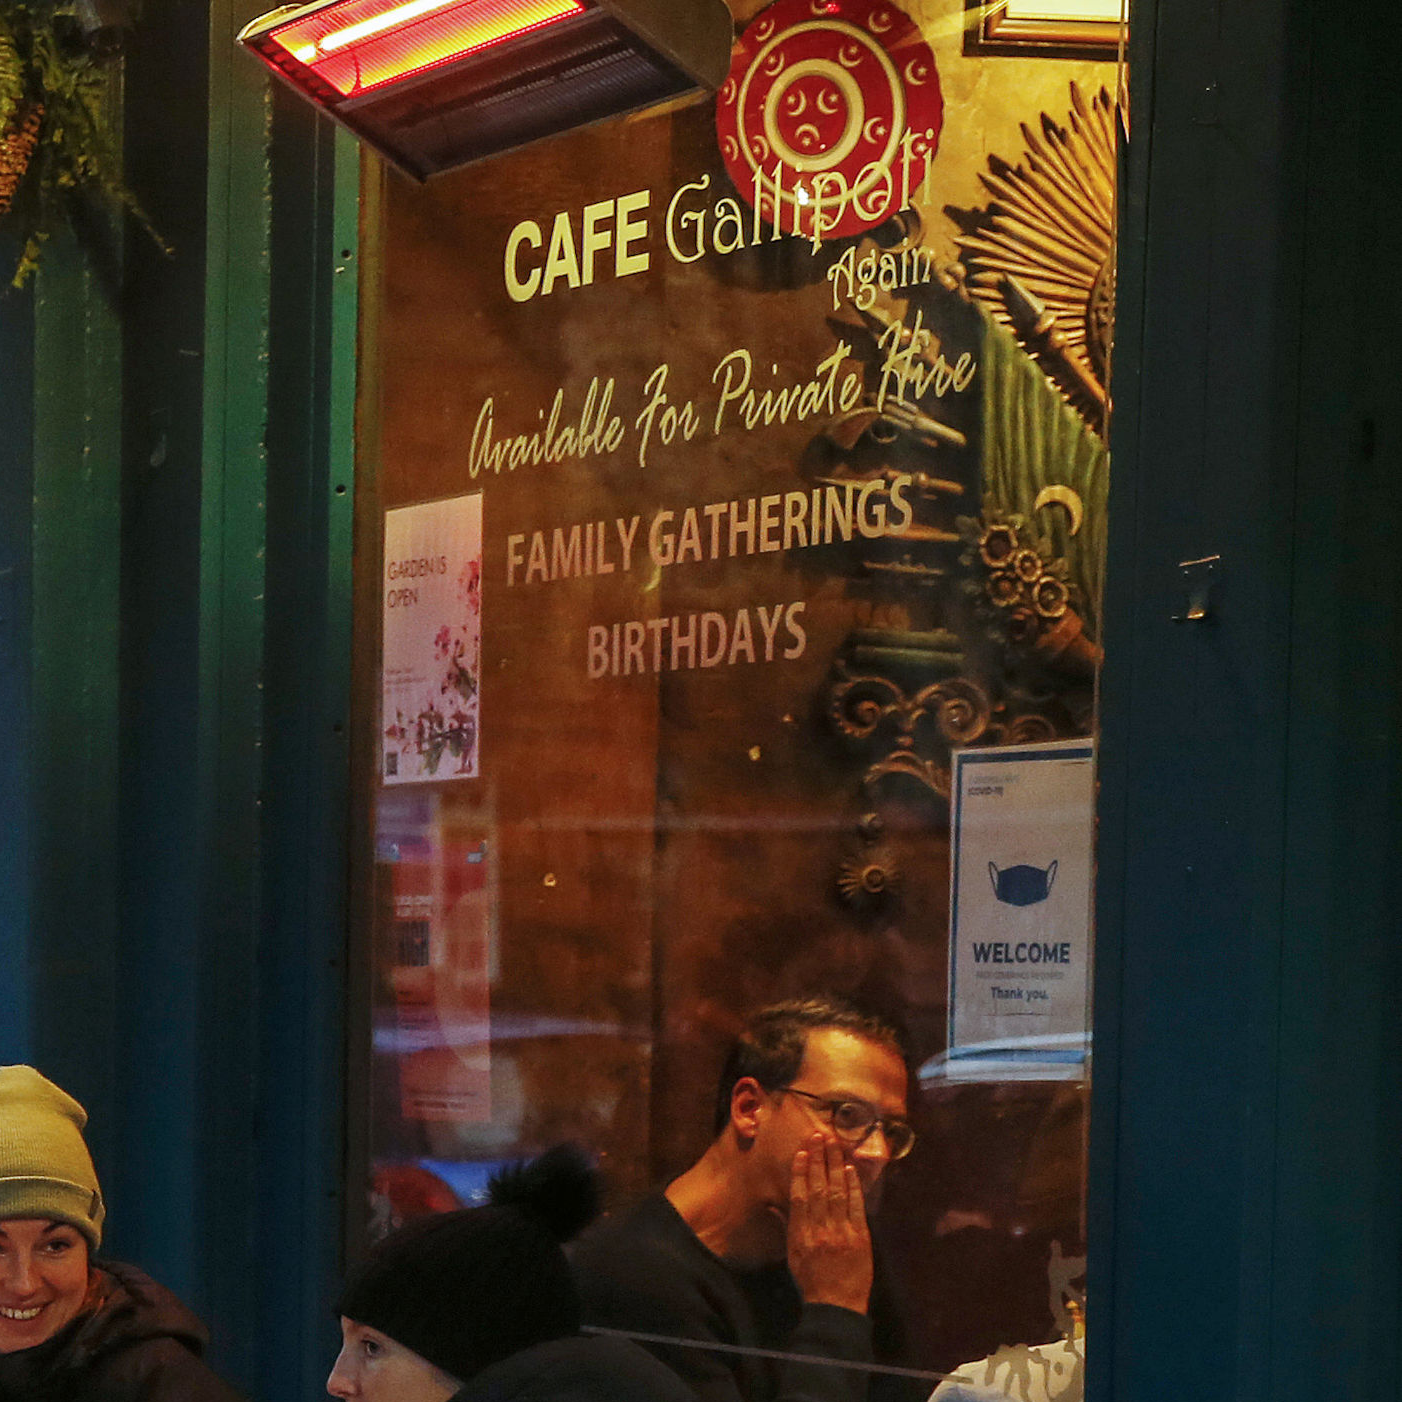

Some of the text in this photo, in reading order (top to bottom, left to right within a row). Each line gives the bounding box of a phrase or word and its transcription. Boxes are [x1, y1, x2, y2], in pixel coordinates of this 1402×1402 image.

[503, 126, 934, 302] CAFE Gallipoli
[826, 236, 932, 311] Again
[469, 308, 976, 480] Available For Private Hire
[505, 476, 914, 587] FAMILY GATHERINGS
[387, 588, 419, 609] OPEN
[586, 602, 807, 680] BIRTHDAYS
[972, 942, 1071, 963] WELCOME
[990, 986, 1023, 1000] Thank
